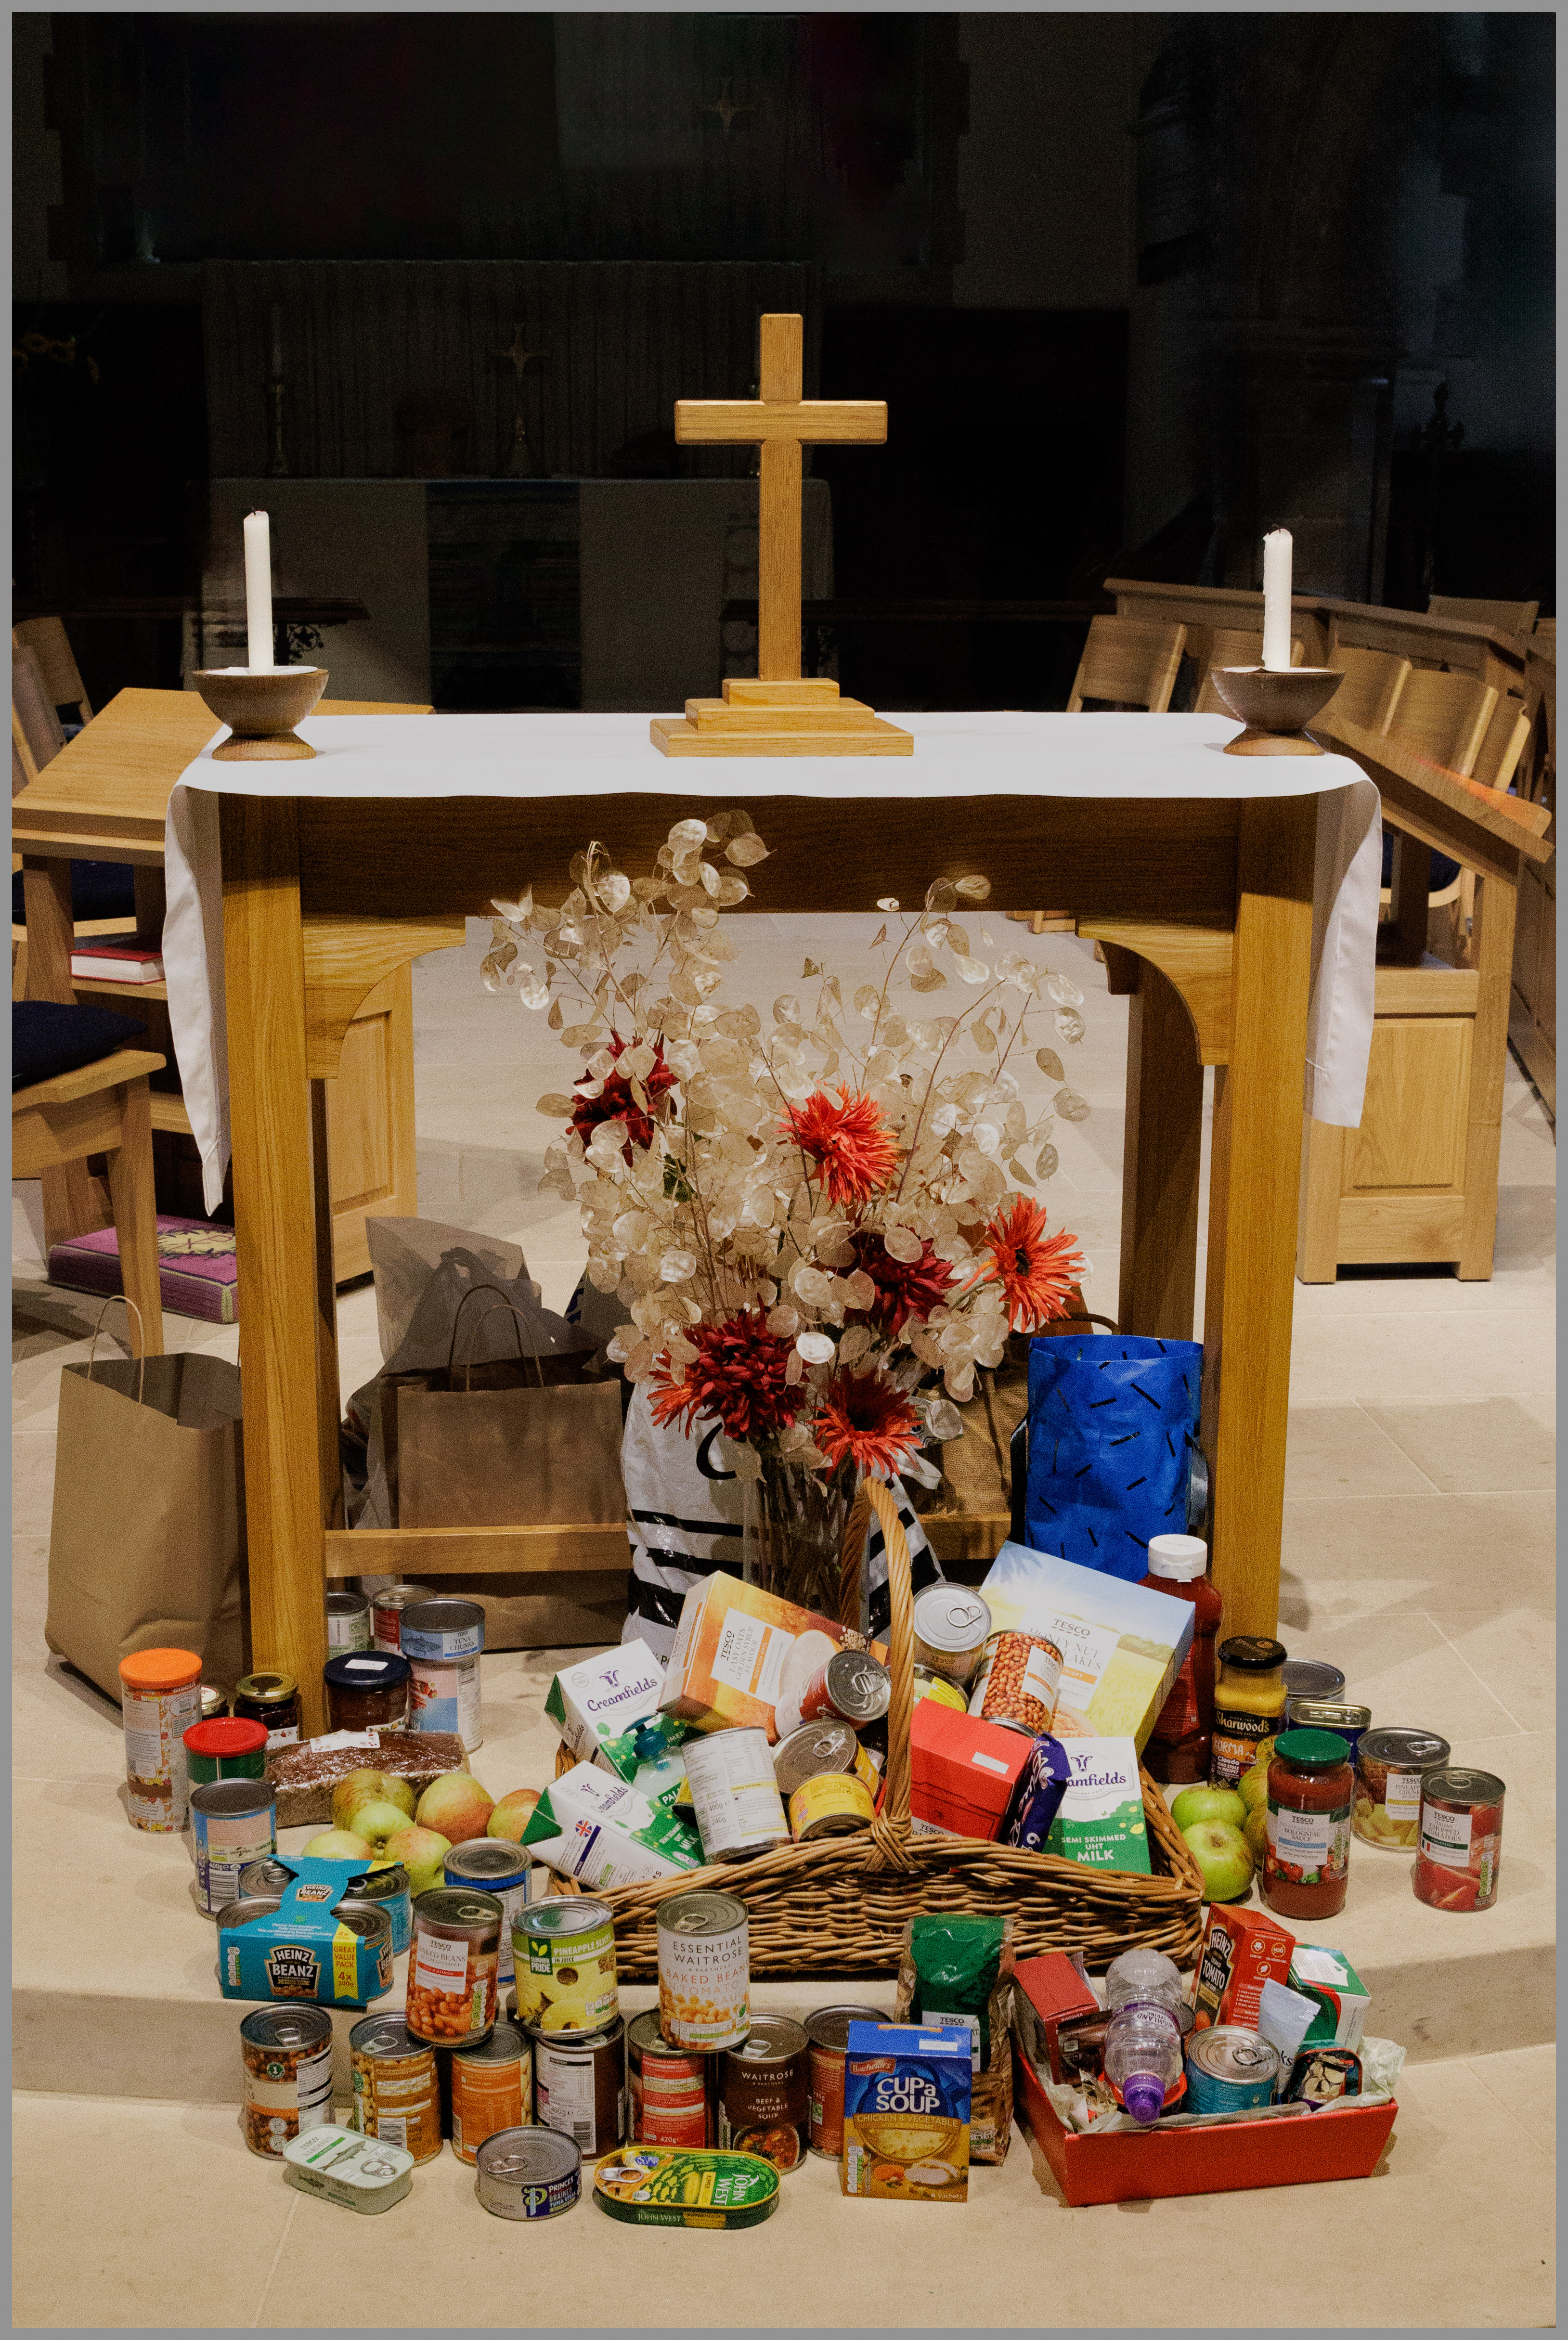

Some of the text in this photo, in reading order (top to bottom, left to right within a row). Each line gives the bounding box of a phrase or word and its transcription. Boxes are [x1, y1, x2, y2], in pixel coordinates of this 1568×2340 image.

[1052, 1618, 1090, 1636] TESCO
[450, 1641, 475, 1651] CHUNKS
[454, 1637, 470, 1645] TUNA
[720, 1630, 733, 1659] TESCO
[729, 1628, 747, 1673] EASY OATS
[736, 1626, 754, 1681] GOLDEN SYRUP
[745, 1639, 758, 1674] FLAVOUR
[1075, 1642, 1102, 1659] NUT
[753, 1653, 764, 1679] SCOTTISH
[1063, 1650, 1102, 1671] LAKES
[1061, 1668, 1083, 1679] CRISPY
[587, 1678, 658, 1711] Creamfields
[1216, 1710, 1270, 1733] Sharwood's
[1218, 1756, 1240, 1766] Cluedo
[1068, 1772, 1126, 1787] amfields
[709, 1803, 724, 1811] 400g
[712, 1816, 726, 1825] 246g
[1434, 1811, 1455, 1822] TESCO
[920, 1823, 945, 1836] TESCO
[1284, 1827, 1321, 1837] BOLOGNESE
[1427, 1827, 1462, 1842] TOMATOES
[1429, 1823, 1460, 1836] CHOPPED
[678, 1833, 699, 1850] MILK
[1084, 1834, 1126, 1843] SKIMMED
[1076, 1849, 1114, 1862] MILK
[430, 1939, 452, 1949] TESCO
[553, 1935, 612, 1957] PINEAPPLE SLICES
[673, 1935, 742, 1954] ESSENTIAL
[1212, 1932, 1231, 1959] HEINZ
[276, 1948, 311, 1962] HEINZ
[419, 1946, 466, 1962] BAKED BEANS
[674, 1946, 743, 1966] WAITROSE
[272, 1963, 315, 1978] BEANZ
[531, 1963, 551, 1973] PRIDE
[665, 1960, 750, 1985] BAKED BEANS
[1203, 1959, 1226, 1990] TOMATO
[338, 1972, 353, 1981] 4x
[679, 1979, 739, 1997] TOMATO
[1061, 2013, 1083, 2022] DISCOVER
[1136, 2012, 1175, 2029] HIGHLAND
[853, 2062, 891, 2072] Batchelors
[741, 2069, 794, 2081] WAITROSE
[747, 2103, 789, 2112] VEGETABLE
[876, 2095, 940, 2114] SOUP
[856, 2114, 897, 2123] CHICKEN
[907, 2115, 959, 2128] VEGETABLE
[299, 2137, 320, 2151] TESCO
[302, 2136, 335, 2157] SARDINES
[660, 2136, 677, 2145] 420g
[548, 2176, 574, 2193] PRINCES
[713, 2178, 736, 2206] WEST
[731, 2172, 752, 2202] JOHN
[549, 2199, 564, 2208] TUNA
[637, 2212, 659, 2222] JOHN
